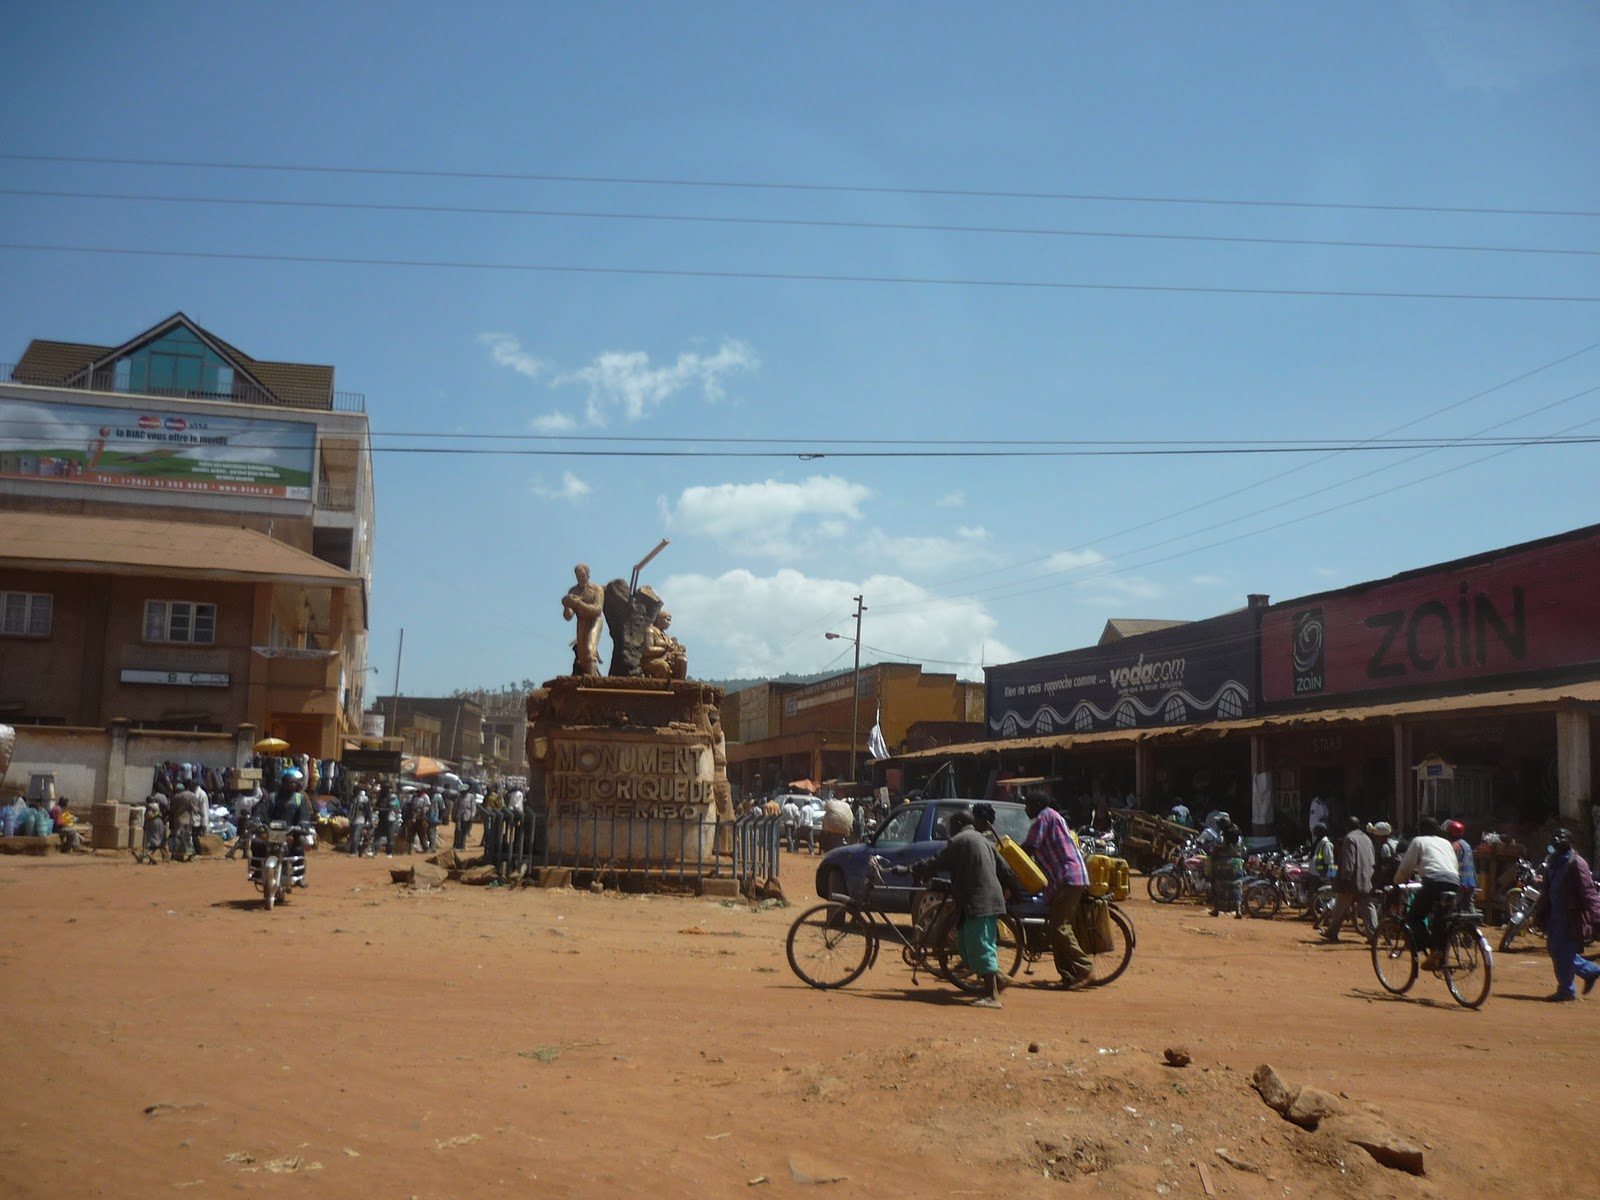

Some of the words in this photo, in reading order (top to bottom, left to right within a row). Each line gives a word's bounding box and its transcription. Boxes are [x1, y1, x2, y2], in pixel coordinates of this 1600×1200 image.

[126, 429, 146, 440] BIAC
[147, 431, 167, 441] vous
[1027, 683, 1041, 695] vous
[1073, 675, 1097, 688] comme
[1110, 653, 1185, 688] vodacom
[555, 743, 704, 775] MONUMENT
[546, 773, 688, 802] HISTORIQUE
[689, 778, 714, 803] DE
